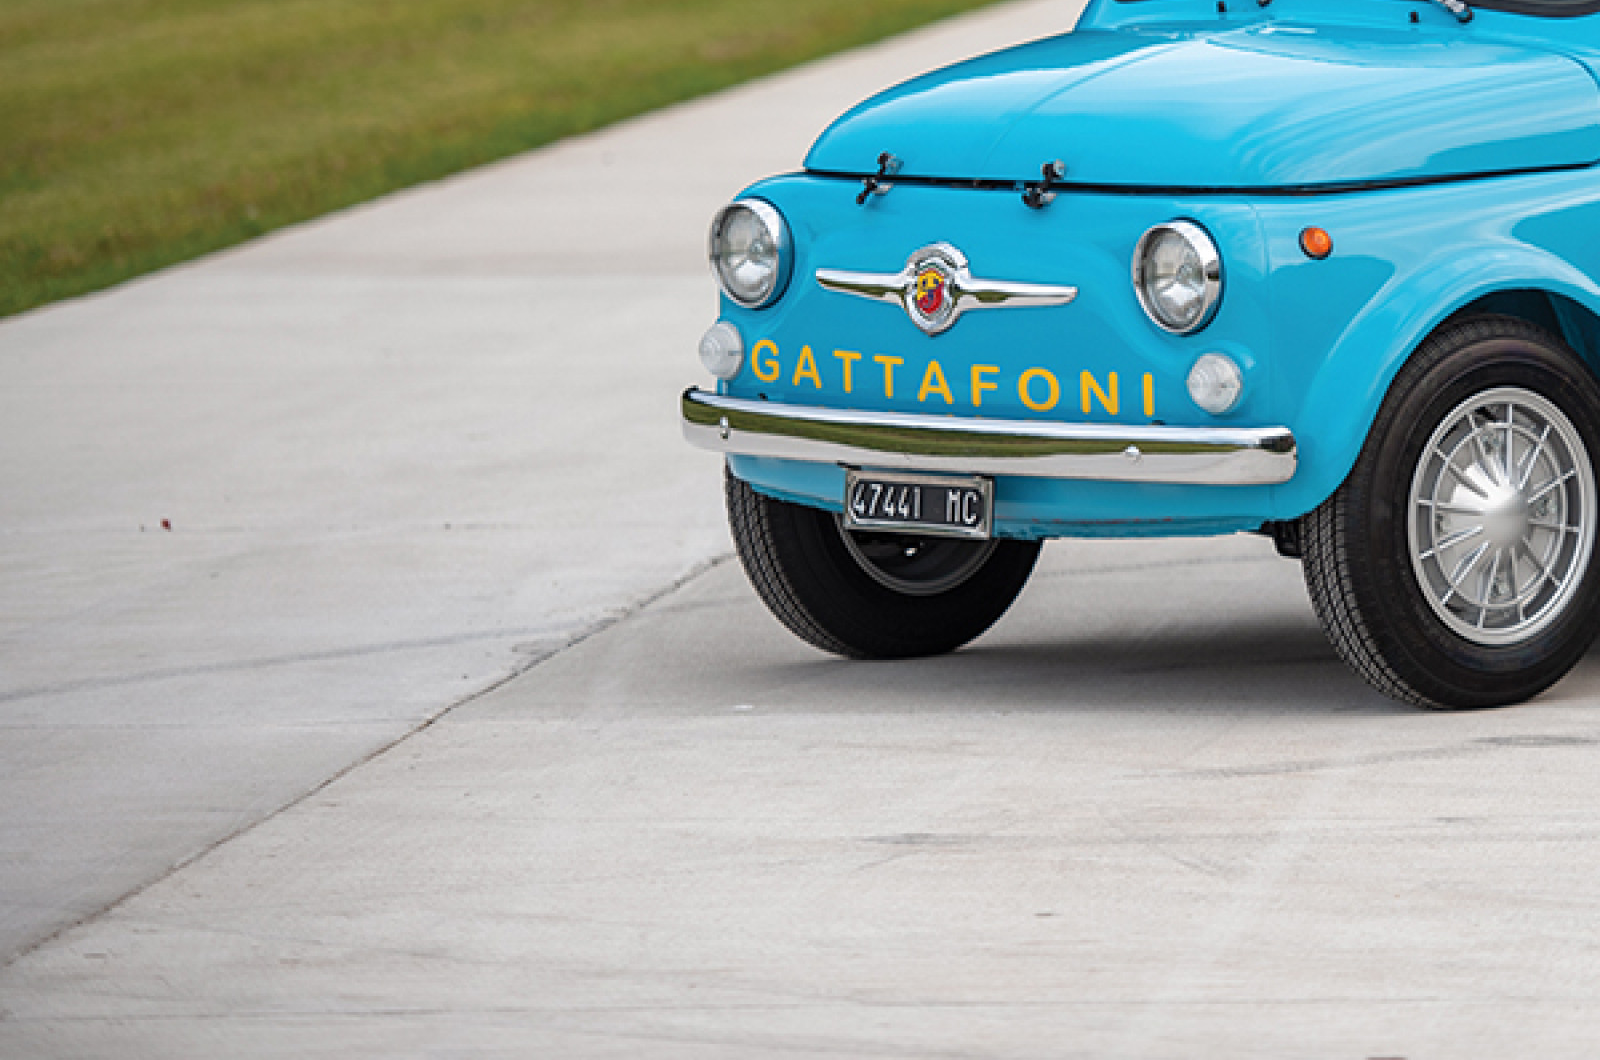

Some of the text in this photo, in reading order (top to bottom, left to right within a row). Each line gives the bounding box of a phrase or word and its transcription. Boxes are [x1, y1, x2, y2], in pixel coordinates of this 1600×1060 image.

[751, 338, 1156, 416] GATTAFONI
[852, 483, 977, 524] 47441 MC
